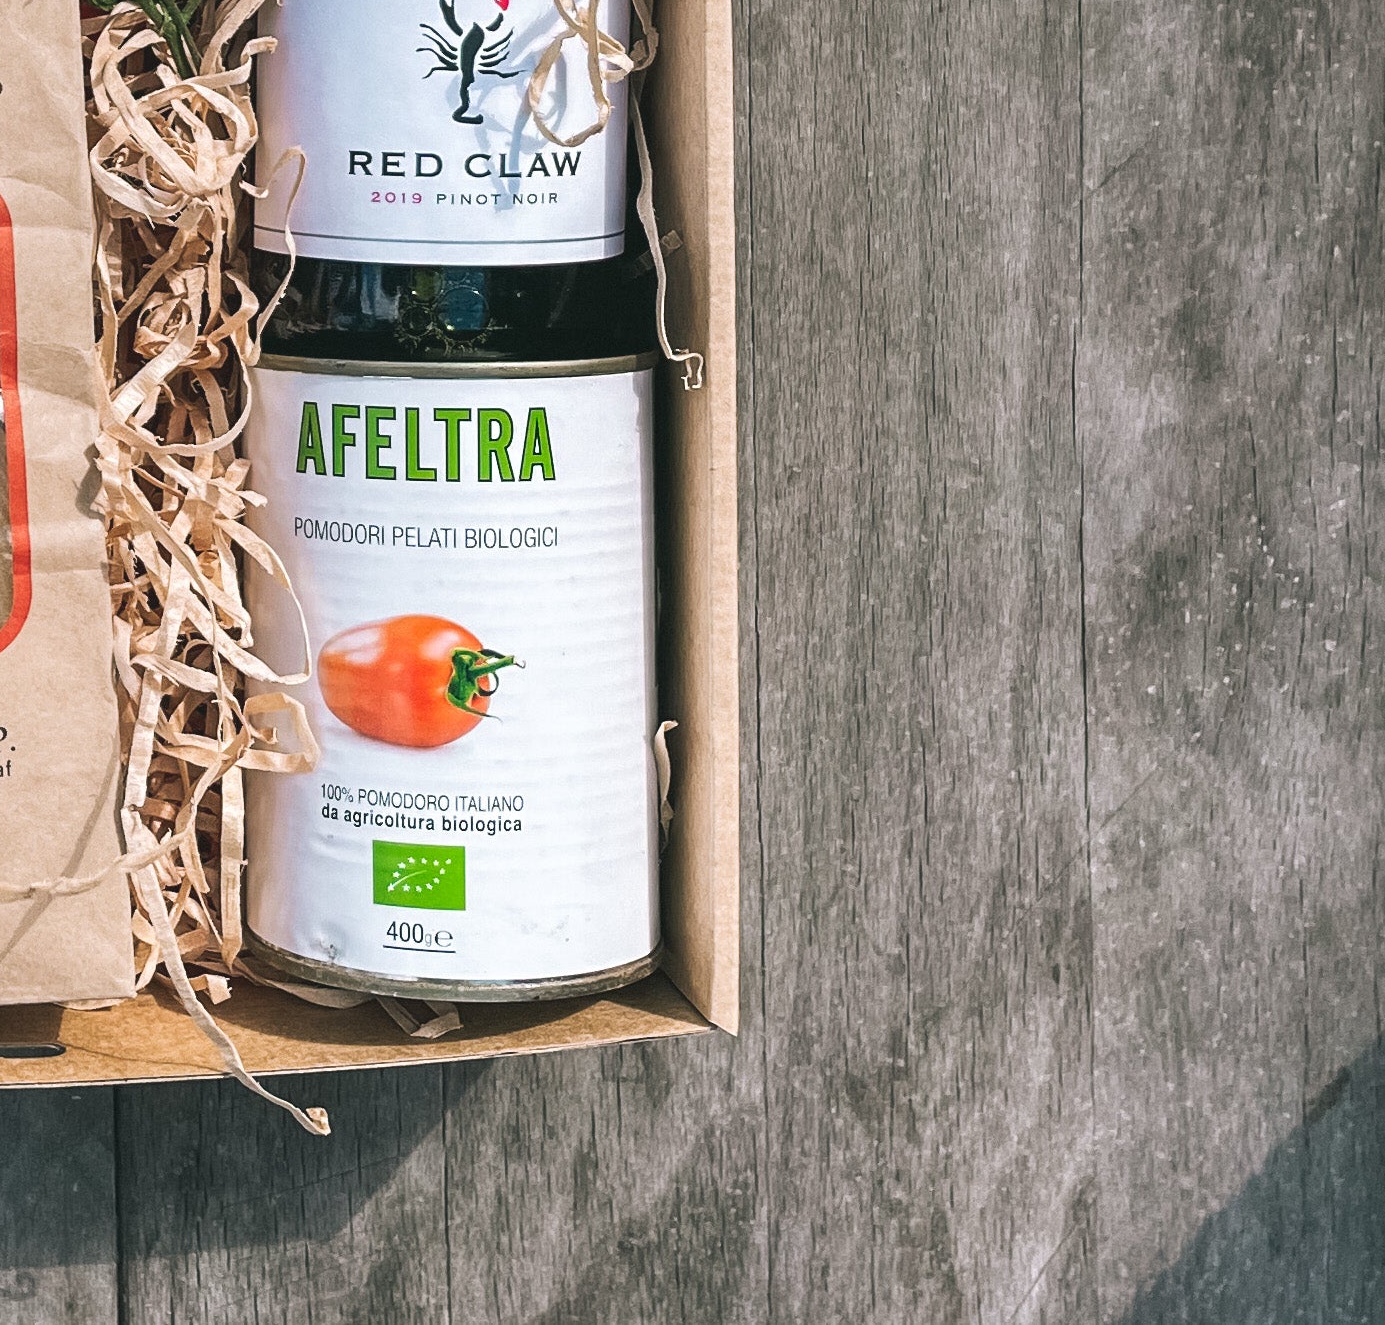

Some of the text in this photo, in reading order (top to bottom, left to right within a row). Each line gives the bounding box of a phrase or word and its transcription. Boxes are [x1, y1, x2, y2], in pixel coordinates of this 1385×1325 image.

[349, 150, 581, 177] RED CLAW
[371, 192, 558, 205] 2019 PINOT NOIR
[296, 401, 556, 482] AFELTRA
[294, 517, 558, 548] POMODORI PELATI BIOLOGICI
[320, 783, 524, 811] 100% POMODORO ITALIANO
[322, 804, 522, 835] da agricoltura biologica
